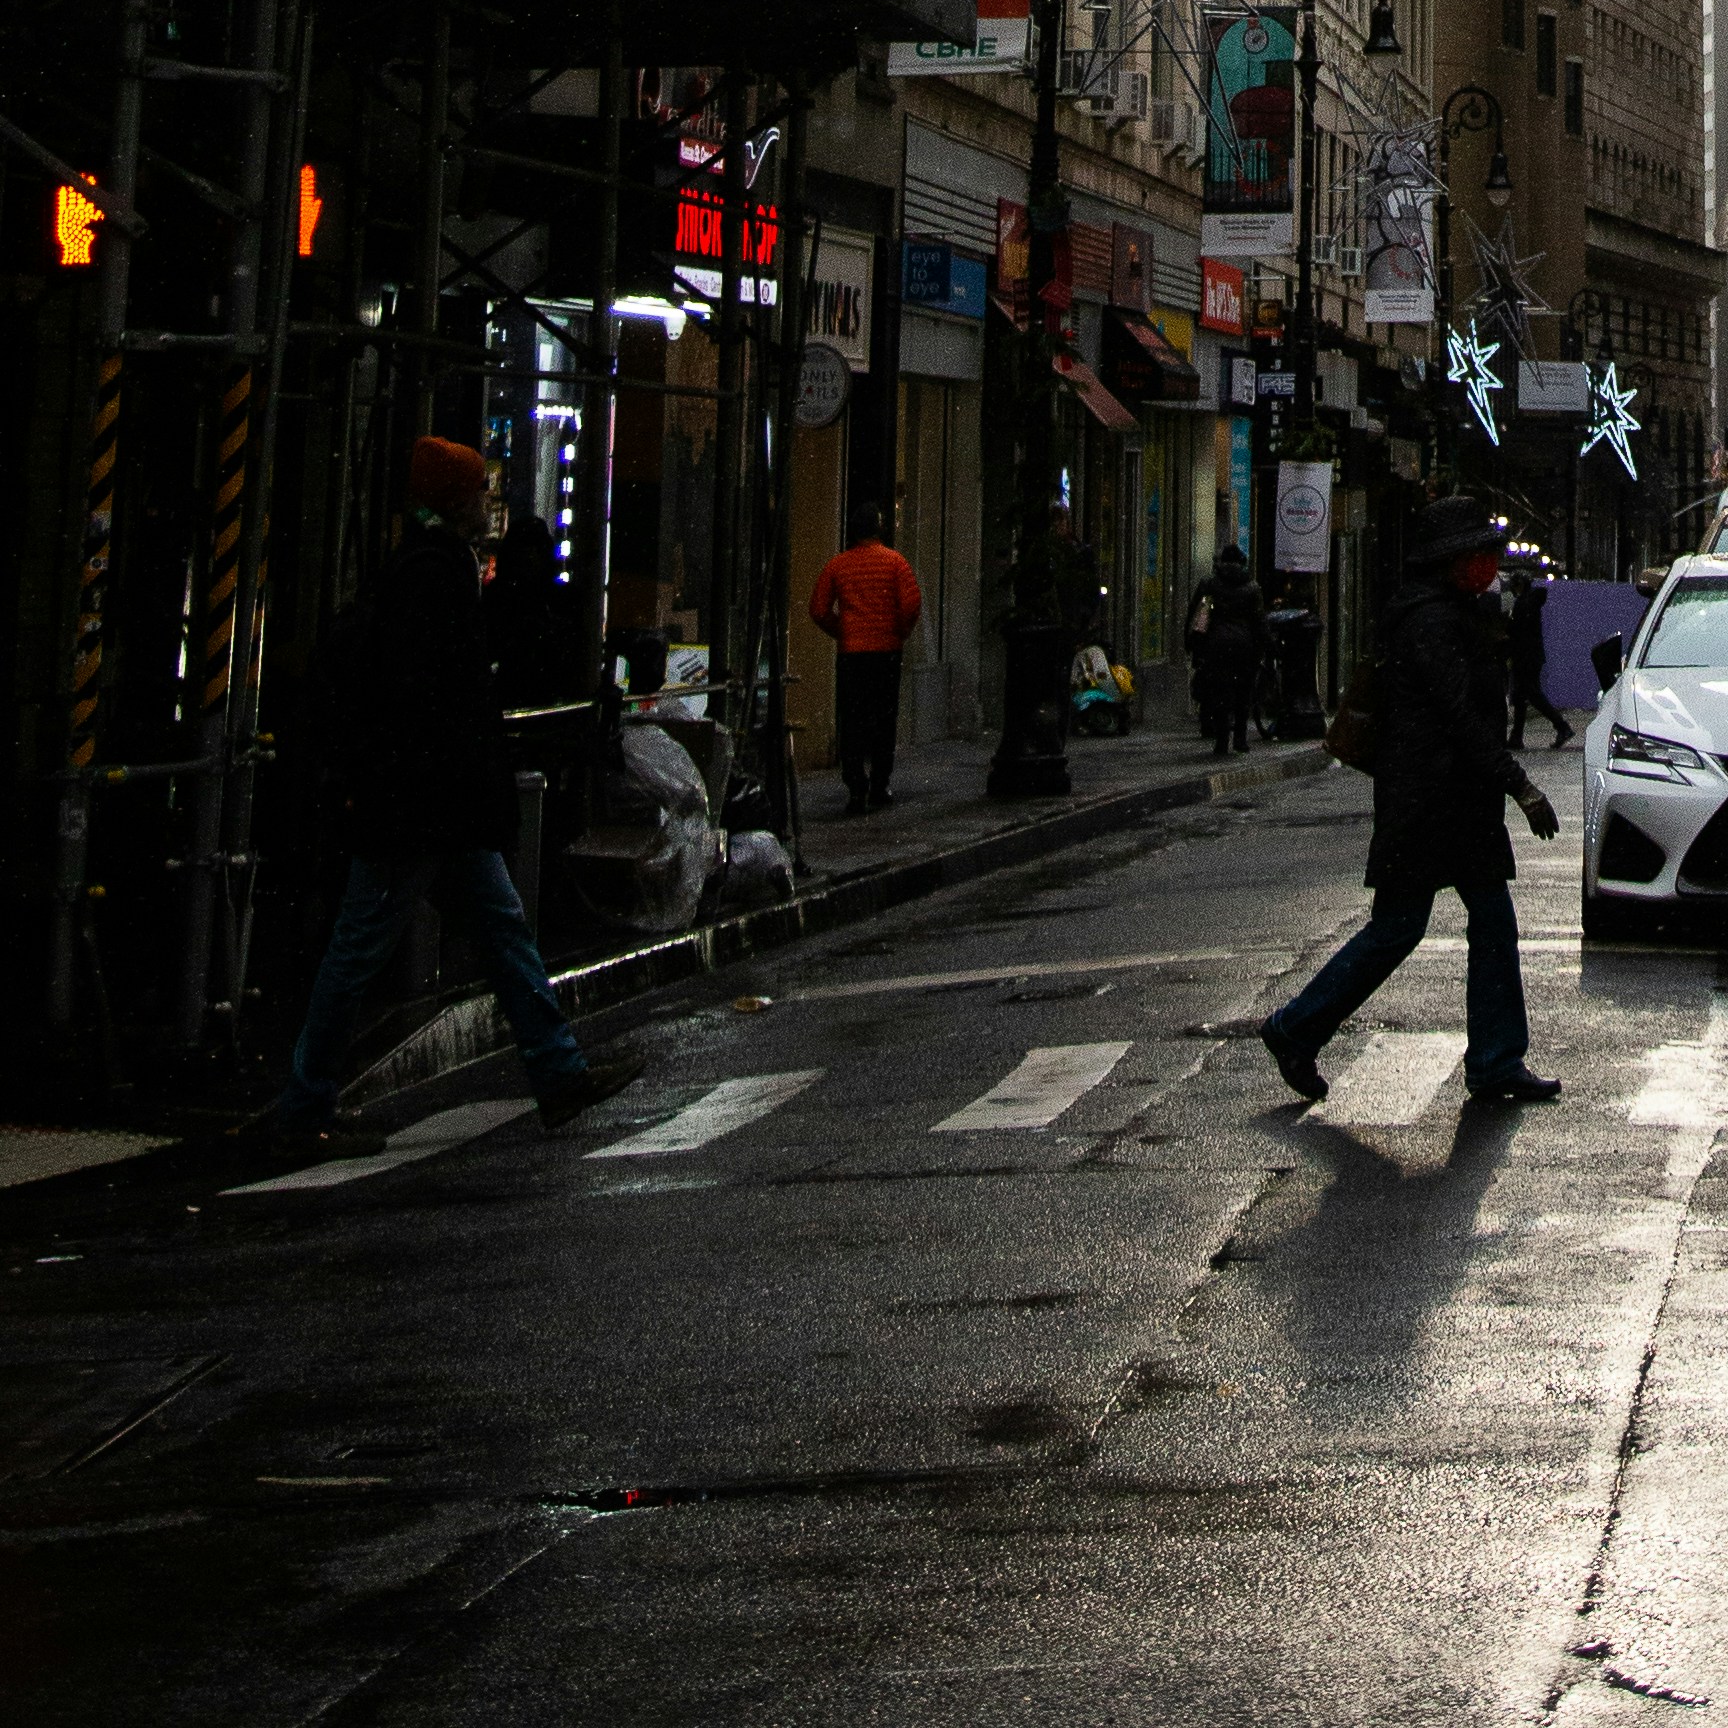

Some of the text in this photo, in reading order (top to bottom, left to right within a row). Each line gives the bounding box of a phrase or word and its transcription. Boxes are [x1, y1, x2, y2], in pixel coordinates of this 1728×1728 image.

[910, 251, 942, 268] eye
[912, 267, 928, 282] to
[909, 281, 941, 298] eye
